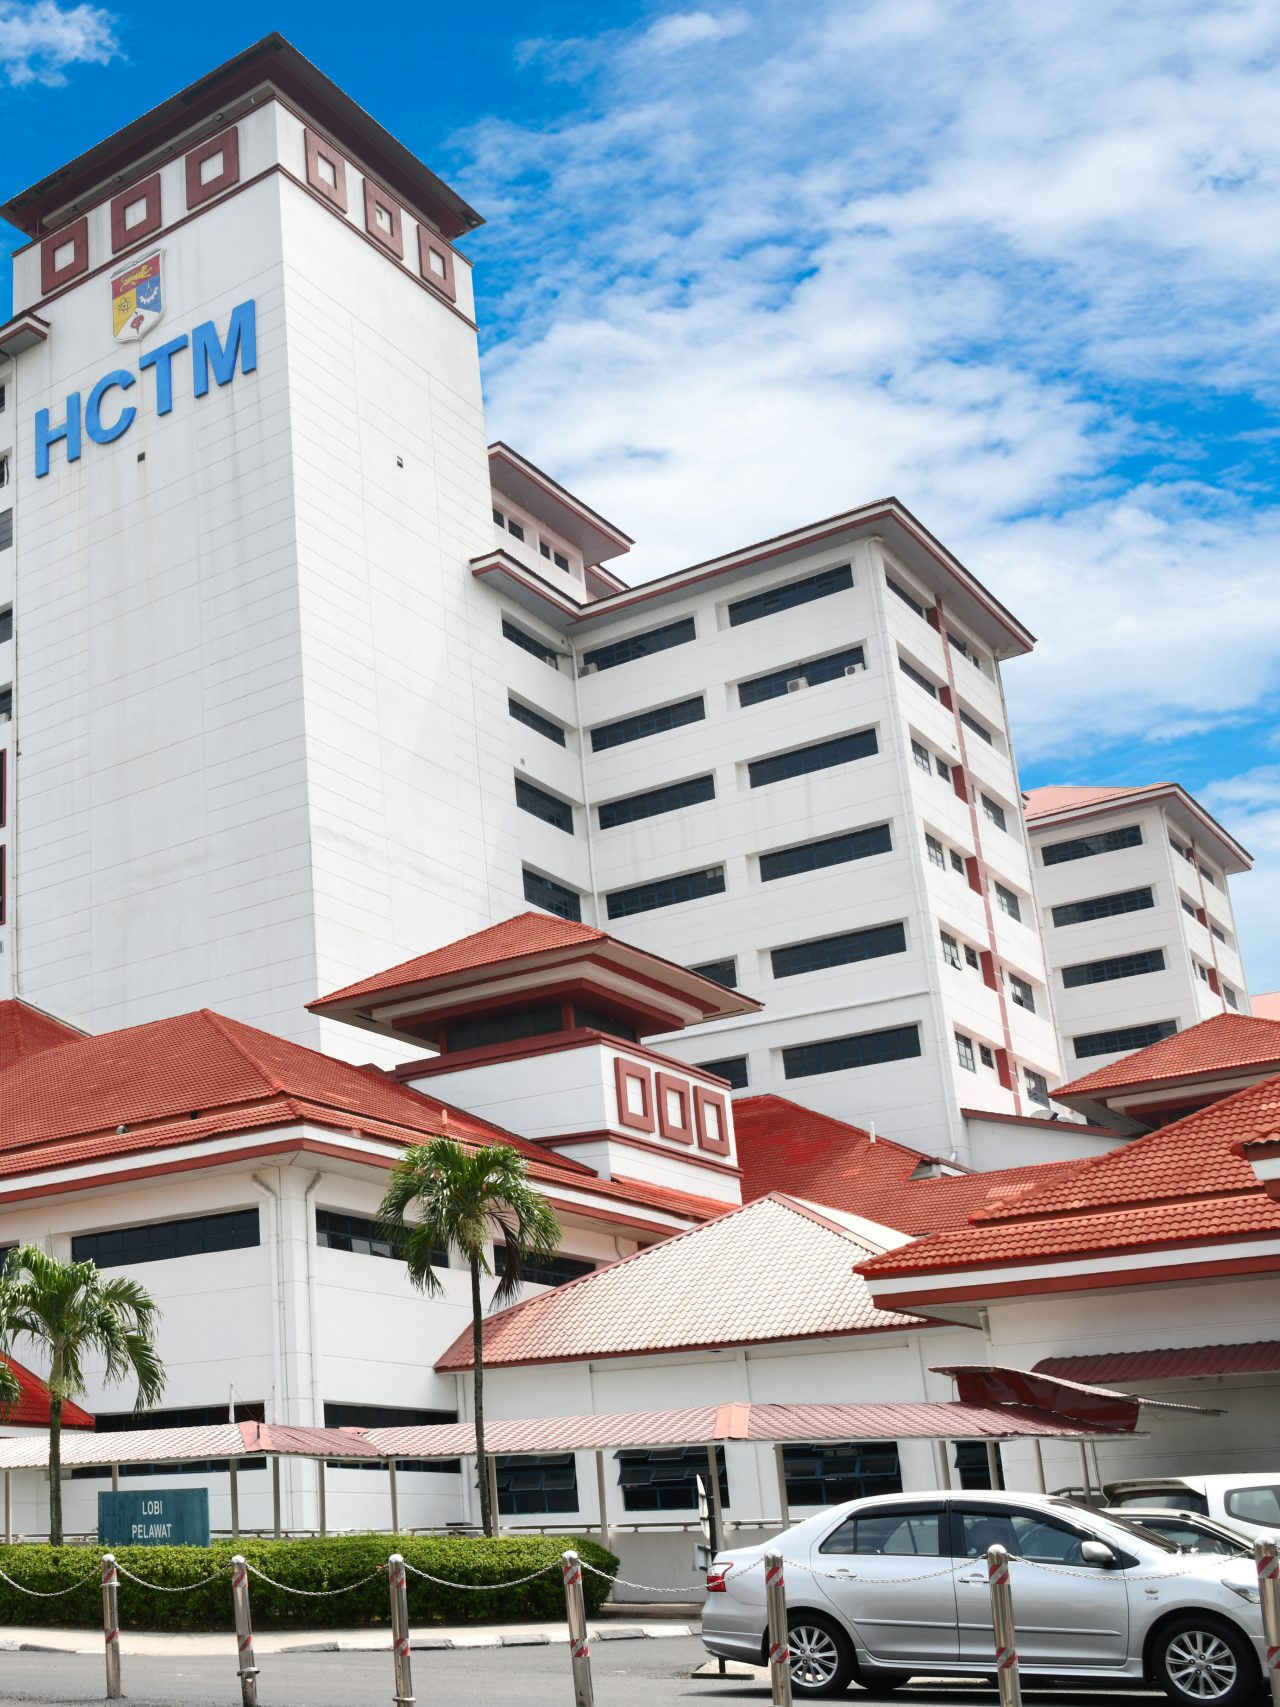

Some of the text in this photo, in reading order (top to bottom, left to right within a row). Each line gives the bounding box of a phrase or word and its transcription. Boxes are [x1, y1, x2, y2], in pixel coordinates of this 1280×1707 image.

[34, 299, 257, 479] HCTM
[142, 1500, 163, 1515] LOBI
[132, 1523, 172, 1539] PELAWAT
